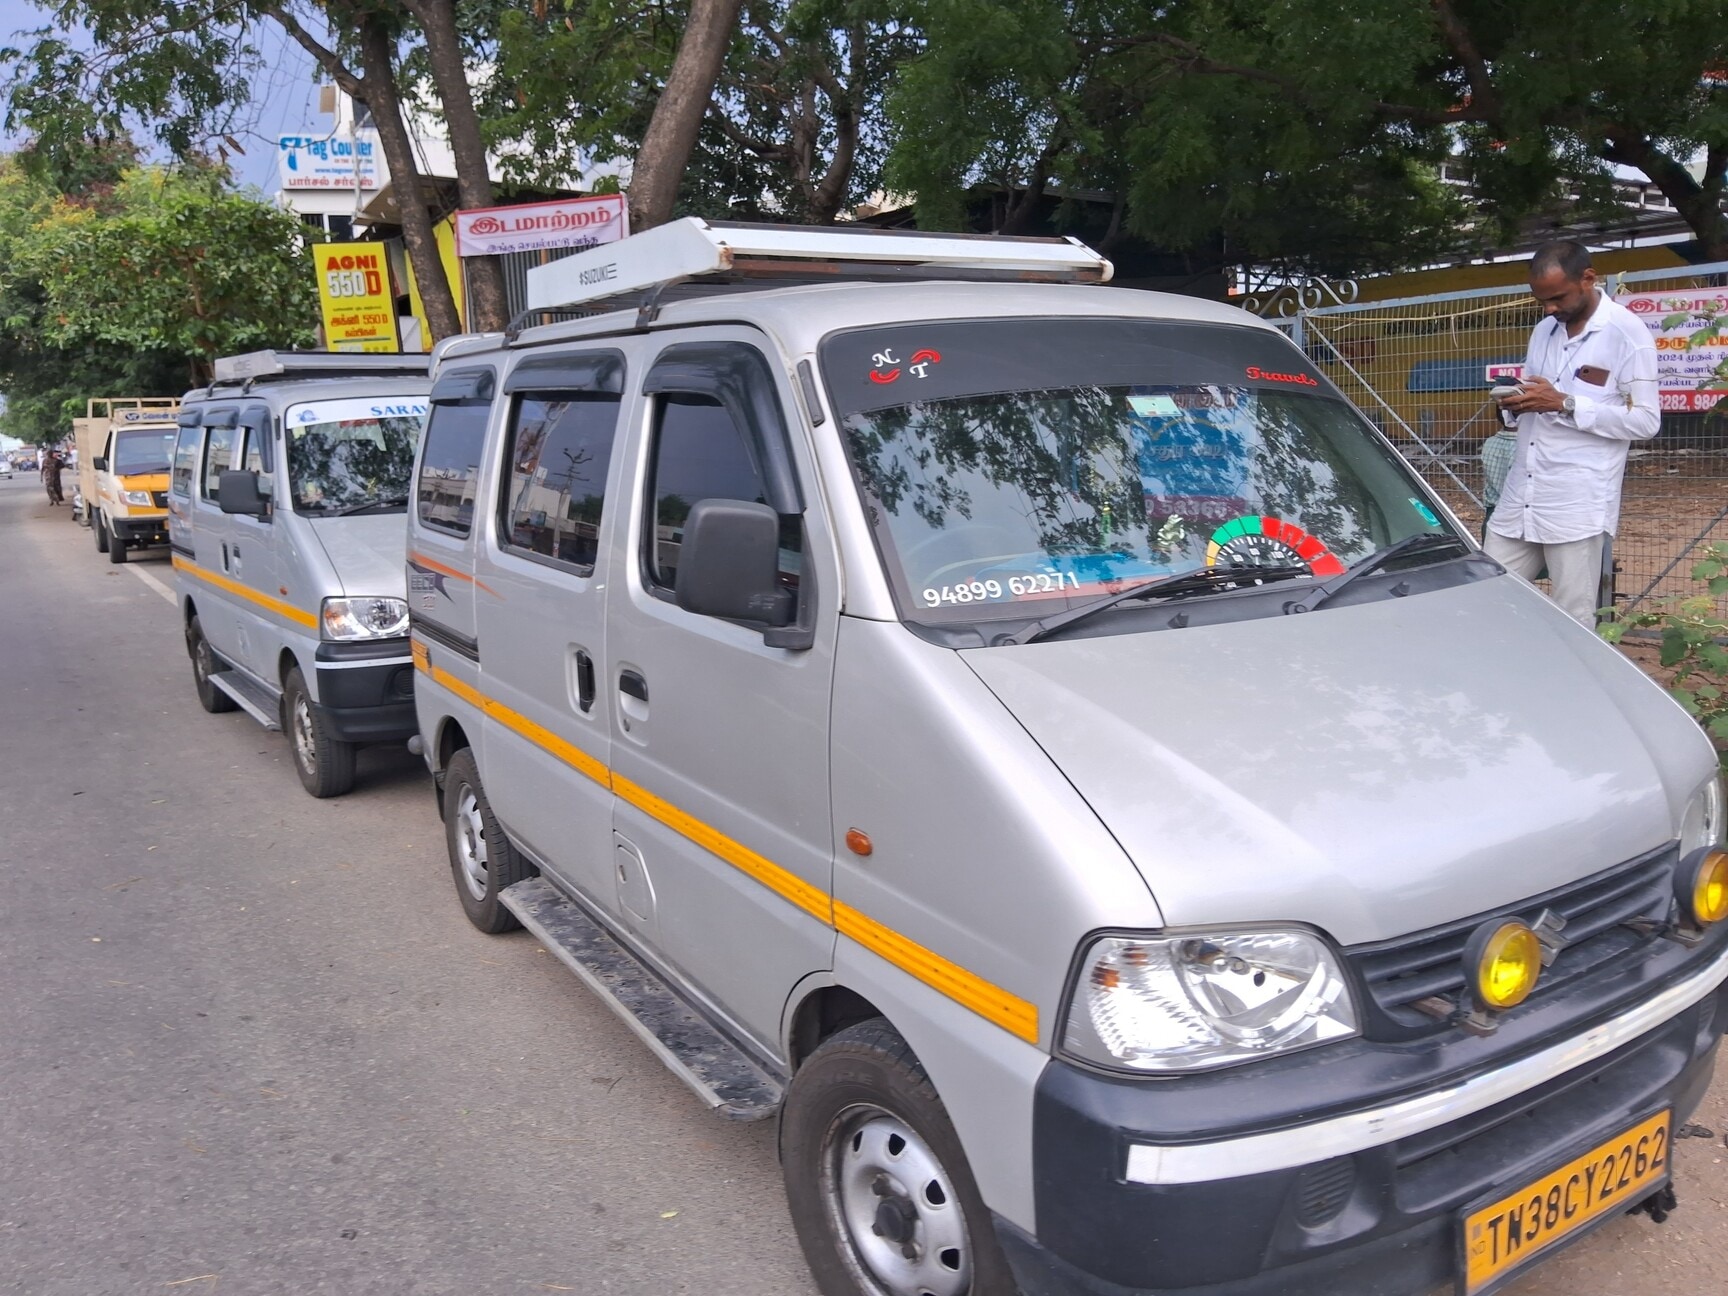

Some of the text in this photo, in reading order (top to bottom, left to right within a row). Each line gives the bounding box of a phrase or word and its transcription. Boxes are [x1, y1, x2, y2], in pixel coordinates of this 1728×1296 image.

[304, 138, 373, 160] Tag Couier
[468, 206, 612, 235] இடமாற்றம்
[327, 255, 378, 271] AGNI
[363, 315, 380, 325] 550
[1246, 366, 1318, 386] Travels
[923, 571, 1080, 608] 94899 62271
[1488, 1125, 1665, 1265] TN38CY2262
